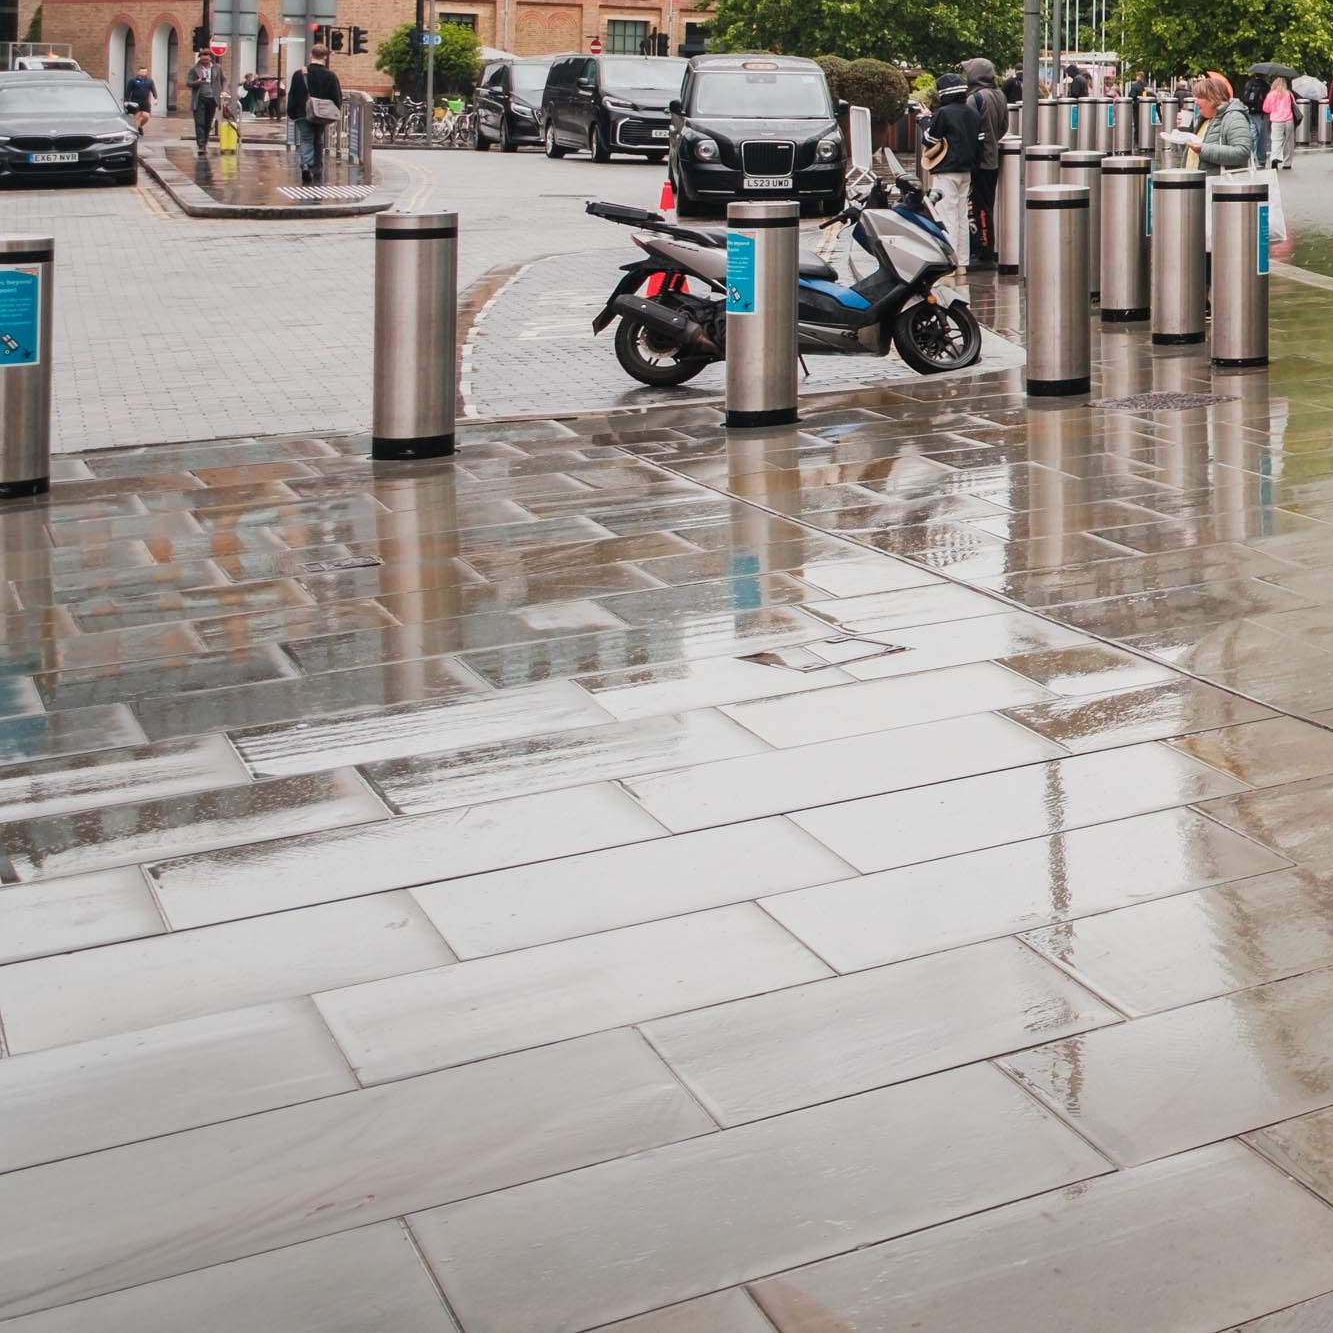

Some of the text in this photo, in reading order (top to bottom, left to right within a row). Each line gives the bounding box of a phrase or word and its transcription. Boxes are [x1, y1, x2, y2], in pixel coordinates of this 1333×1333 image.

[34, 153, 77, 162] EX67 NVR
[747, 179, 789, 187] LS23 UWD
